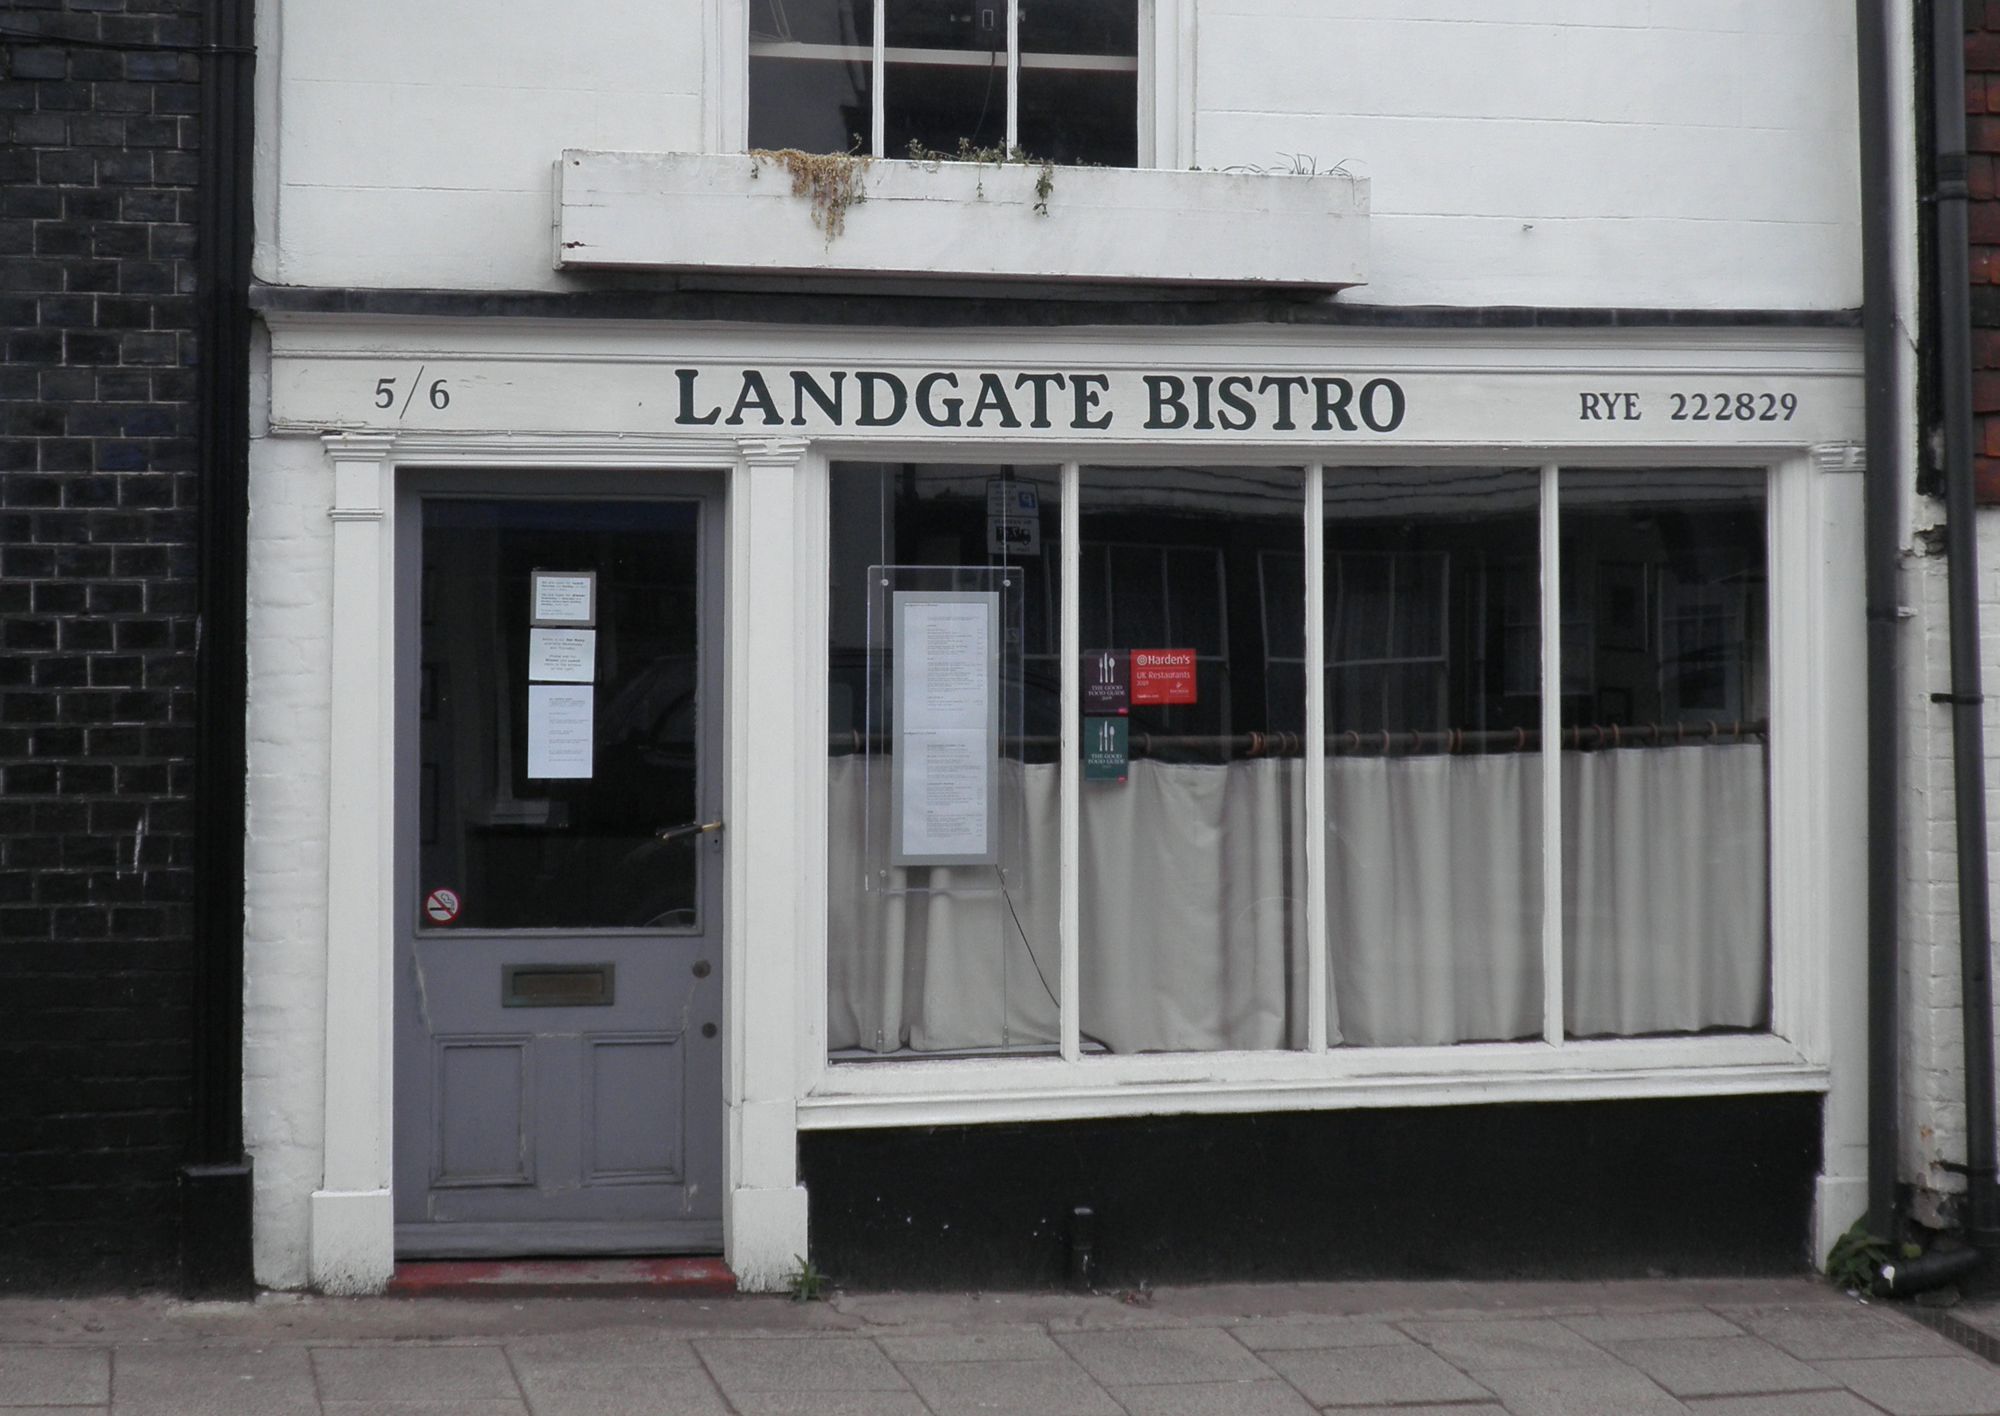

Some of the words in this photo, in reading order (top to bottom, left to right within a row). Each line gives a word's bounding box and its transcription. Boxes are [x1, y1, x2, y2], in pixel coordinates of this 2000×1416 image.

[374, 365, 451, 419] 5/6
[674, 369, 1112, 428] LANDGATE
[1143, 375, 1405, 432] BISTRO
[1580, 392, 1641, 421] RYE
[1670, 392, 1797, 421] 222829
[1148, 654, 1191, 665] Harden's
[1136, 671, 1147, 679] UK
[1148, 671, 1191, 680] Restaurants
